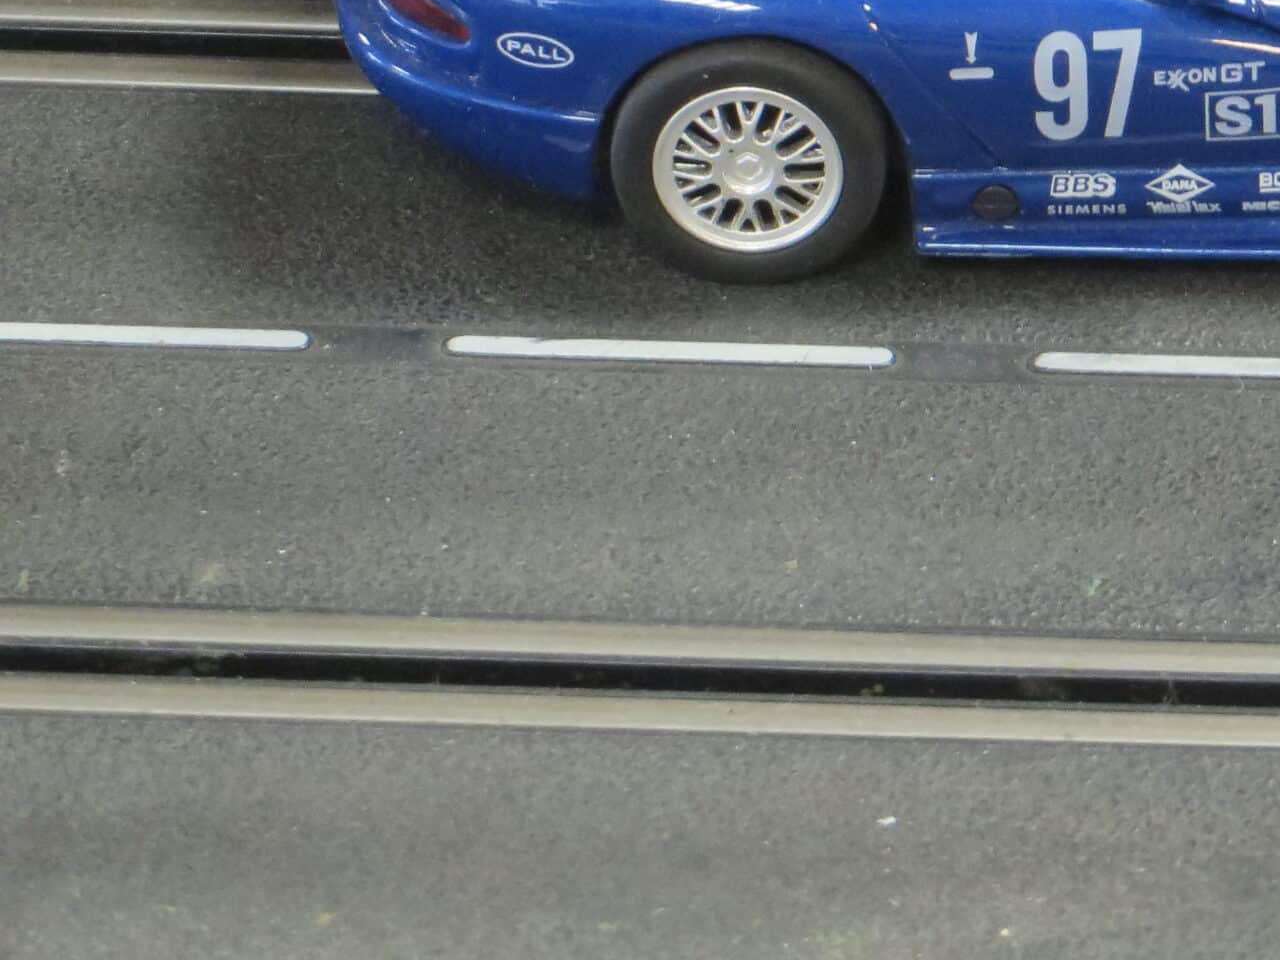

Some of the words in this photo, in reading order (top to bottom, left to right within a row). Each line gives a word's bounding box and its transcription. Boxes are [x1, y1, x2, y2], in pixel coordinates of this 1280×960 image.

[506, 40, 567, 61] PALL
[1220, 61, 1266, 83] GT
[1034, 28, 1142, 140] 97
[1214, 94, 1277, 136] S1
[1051, 174, 1117, 198] BBS
[1161, 179, 1198, 191] DANA
[1047, 203, 1128, 215] SIEMENS
